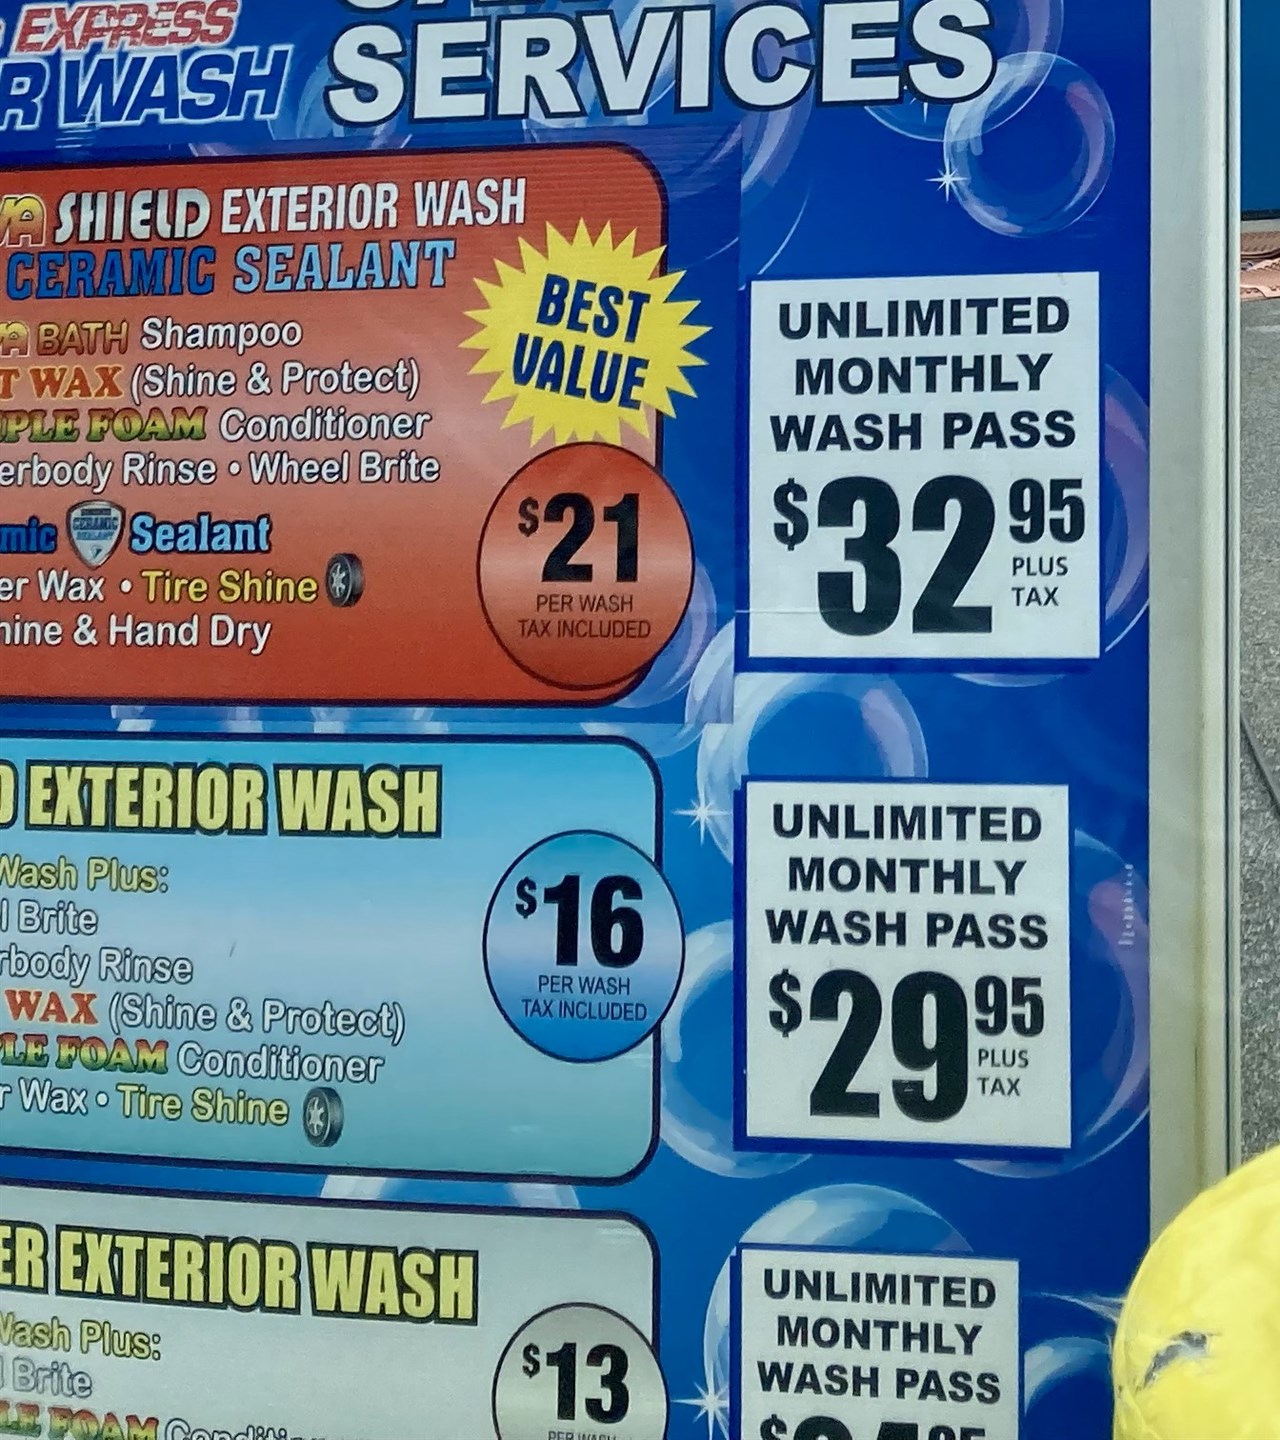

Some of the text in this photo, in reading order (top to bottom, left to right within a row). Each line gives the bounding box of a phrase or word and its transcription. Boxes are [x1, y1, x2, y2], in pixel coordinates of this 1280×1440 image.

[59, 45, 294, 127] WASH
[54, 189, 211, 244] SHIELD
[221, 181, 398, 234] EXTERIOR
[413, 177, 527, 228] WASH
[6, 238, 457, 300] CERAMIC SEALANT
[536, 272, 652, 344] BEST
[778, 295, 1070, 340] UNLIMITED
[37, 320, 129, 356] BATH
[141, 315, 303, 356] Shampoo
[29, 364, 124, 400] WAX
[130, 360, 237, 406] (Shine
[246, 360, 272, 396] &
[281, 356, 420, 402] Protect)
[512, 333, 650, 411] VALUE
[794, 353, 1054, 396] MONTHLY
[87, 406, 208, 443] FOAM
[219, 405, 432, 443] Conditioner
[769, 410, 1077, 453] WASH PASS
[122, 451, 217, 486] Rinse
[249, 449, 351, 484] Wheel
[358, 447, 441, 484] Brite
[130, 511, 272, 554] Sealant
[516, 490, 641, 585] $21
[37, 568, 105, 602] Wax
[141, 569, 209, 603] Tire
[218, 568, 319, 604] Shine
[1011, 556, 1069, 578] PLUS
[535, 592, 634, 614] PER WASH
[1010, 586, 1060, 608] TAX
[72, 613, 98, 647] &
[108, 613, 199, 647] Hand
[210, 613, 272, 656] Dry
[518, 616, 652, 640] TAX INCLUDED
[26, 761, 267, 833] EXTERIOR
[275, 765, 442, 837] WASH
[771, 803, 1043, 844] UNLIMITED
[87, 856, 169, 893] Plus:
[787, 856, 1027, 896] MONTHLY
[18, 898, 98, 935] Brite
[514, 874, 645, 969] $16
[765, 909, 1050, 951] WASH PASS
[98, 947, 194, 984] Rinse
[537, 974, 631, 996] PER WASH
[4, 989, 406, 1046] WAX (Shine & Protect)
[521, 998, 648, 1022] TAX INCLUDED
[55, 1035, 169, 1074] FOAM
[177, 1041, 385, 1084] Conditioner
[977, 1048, 1030, 1070] PLUS
[18, 1077, 289, 1126] Wax Tire Shine
[976, 1076, 1022, 1098] TAX
[56, 1225, 300, 1313] EXTERIOR
[309, 1242, 479, 1323] WASH
[763, 1267, 998, 1309] UNLIMITED
[80, 1318, 162, 1361] Plus:
[776, 1315, 983, 1356] MONTHLY
[12, 1356, 93, 1399] Brite
[522, 1342, 629, 1424] $13
[757, 1360, 1001, 1404] WASH PASS
[48, 1405, 159, 1440] FOAM
